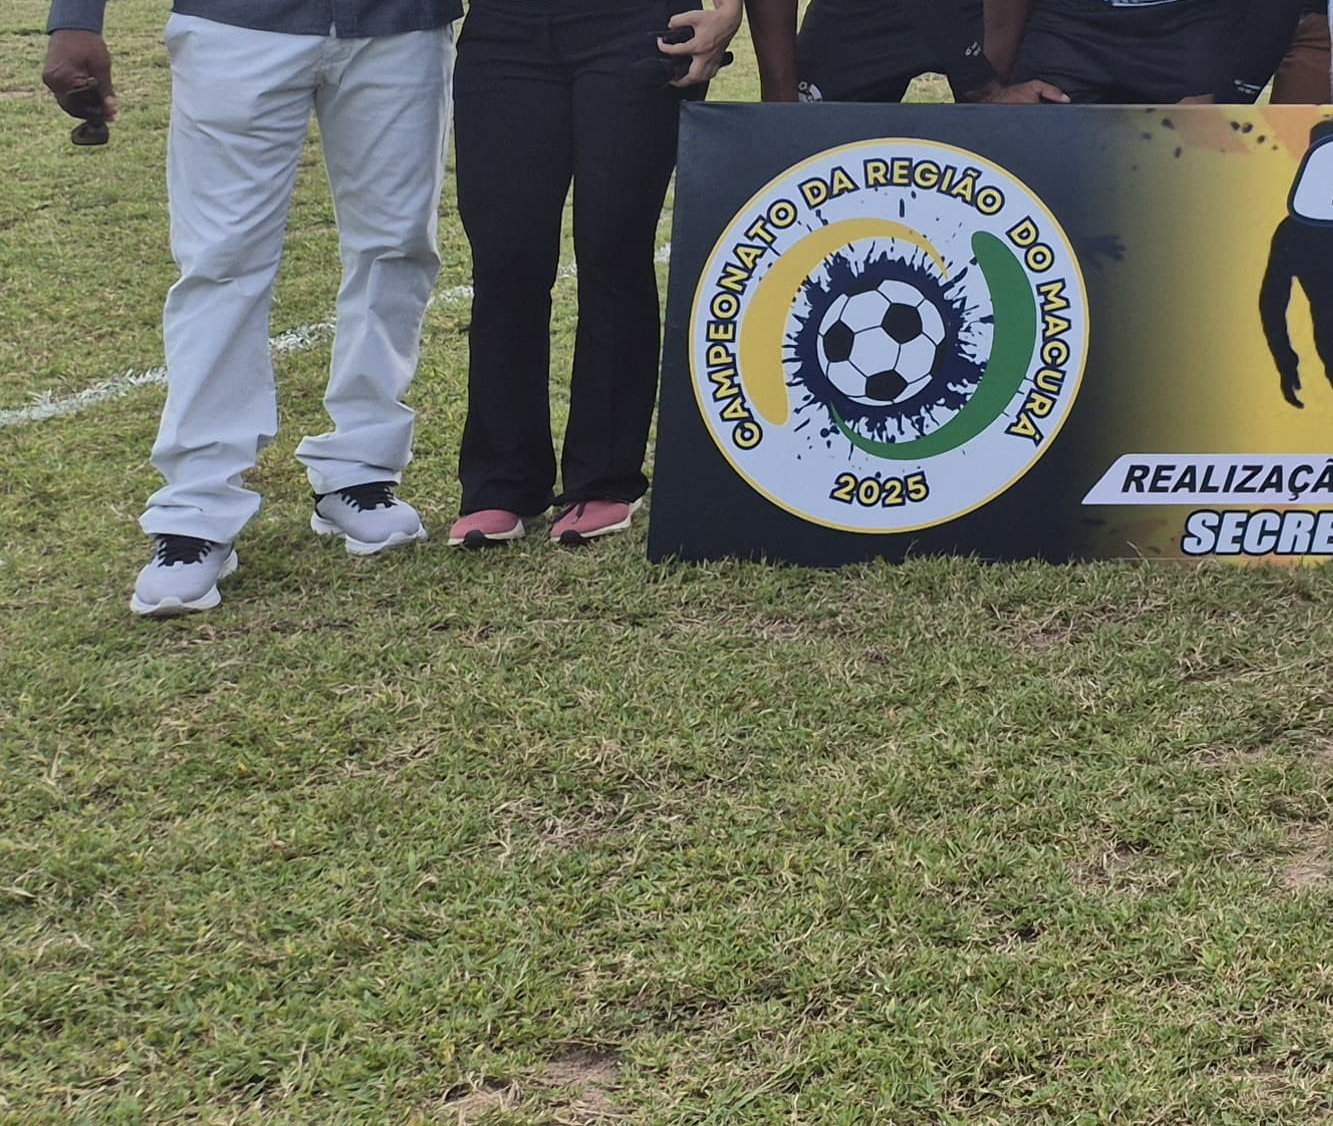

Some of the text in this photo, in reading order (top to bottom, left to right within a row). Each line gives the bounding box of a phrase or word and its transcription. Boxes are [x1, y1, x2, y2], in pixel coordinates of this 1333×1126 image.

[706, 156, 1072, 451] CAMPEONATO DA REGIÃO DO MACURÁ
[830, 472, 930, 506] 2025
